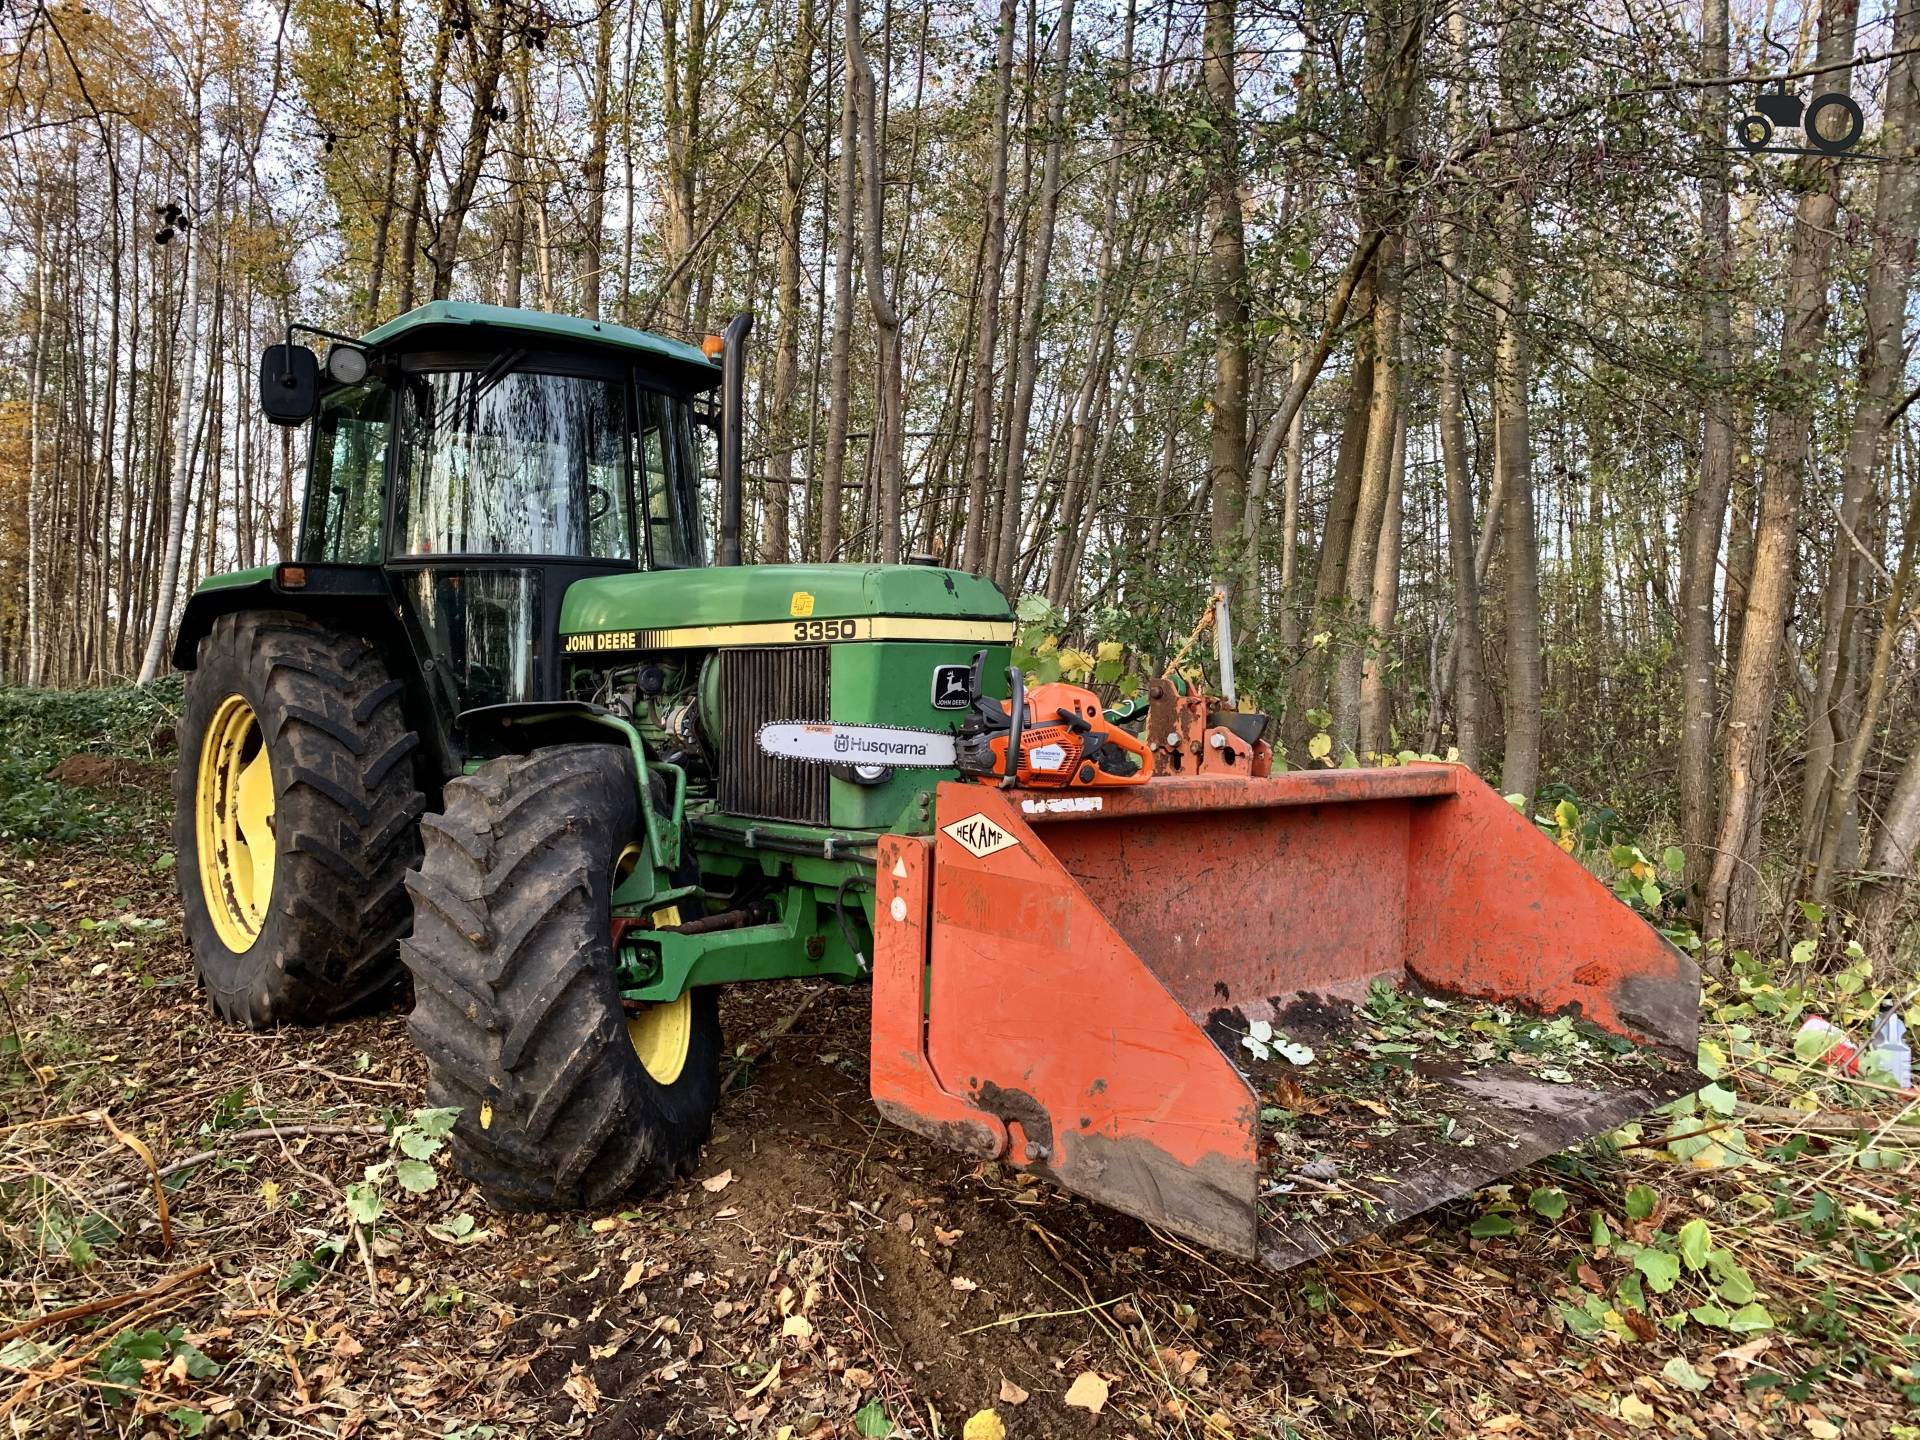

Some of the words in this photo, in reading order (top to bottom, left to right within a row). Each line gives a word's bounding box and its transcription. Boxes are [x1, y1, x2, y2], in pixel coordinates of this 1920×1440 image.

[794, 619, 856, 641] 3350
[565, 634, 594, 651] JOHN
[597, 632, 636, 650] DEERE
[850, 737, 927, 756] Husqvarna
[956, 821, 1003, 850] HEKAMP
